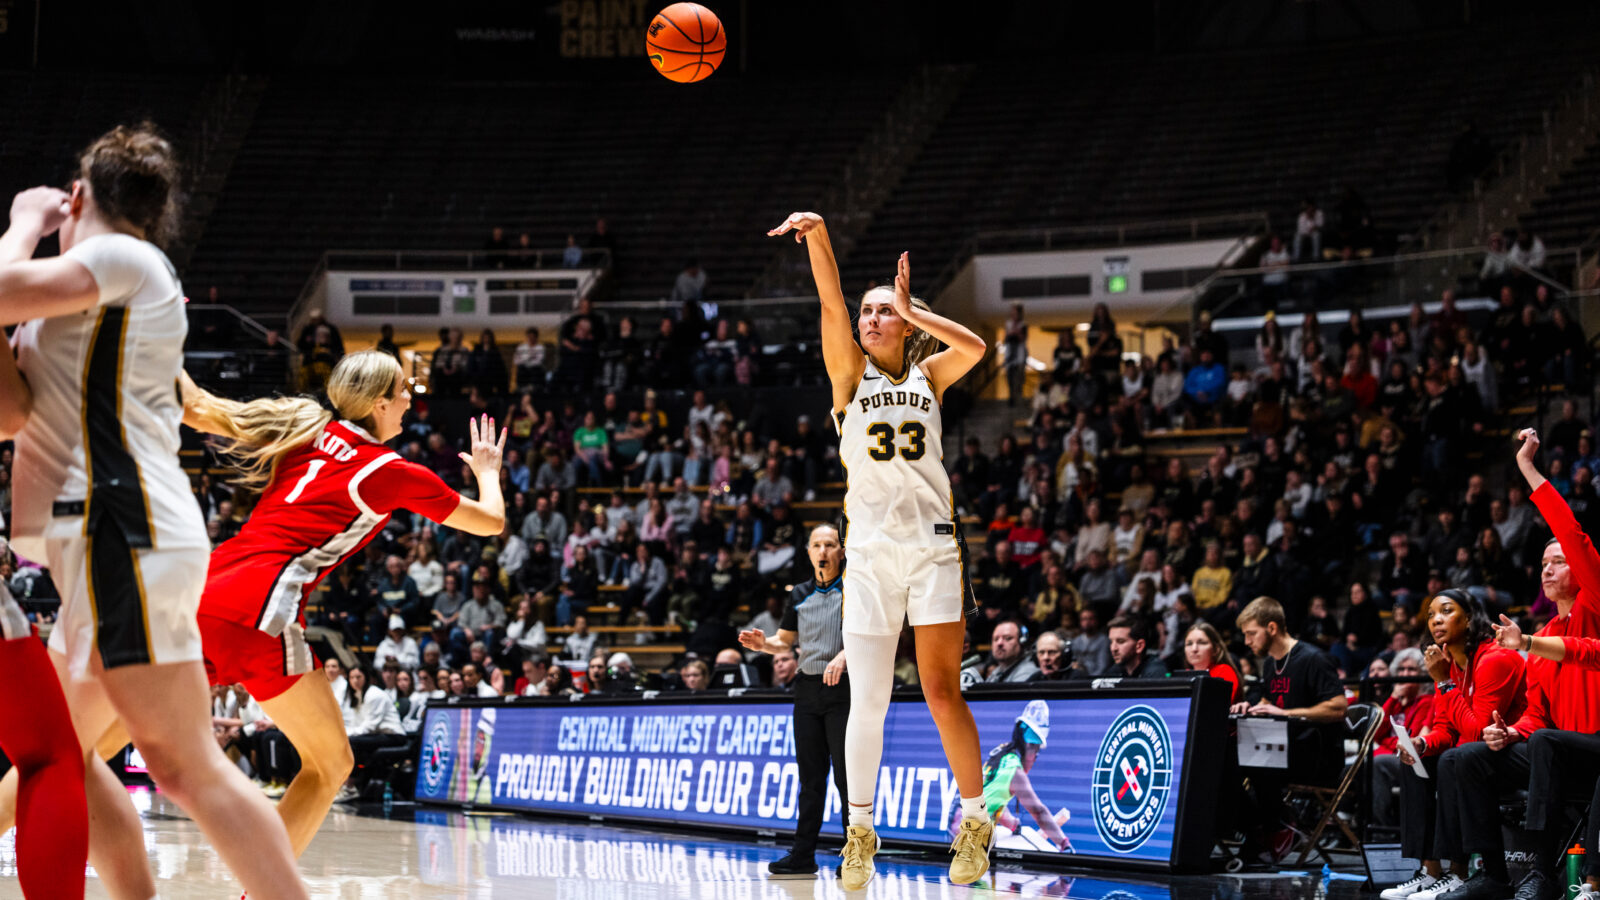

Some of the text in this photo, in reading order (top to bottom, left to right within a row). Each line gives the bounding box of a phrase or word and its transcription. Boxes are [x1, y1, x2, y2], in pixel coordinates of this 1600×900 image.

[560, 29, 645, 58] CREW
[859, 391, 932, 413] PURDUE
[866, 420, 926, 461] 33
[283, 458, 327, 504] 1
[557, 714, 797, 757] CENTRAL MIDWEST CARPEN
[1104, 720, 1165, 765] CENTRAL MIDWEST
[495, 753, 585, 803] PROUDLY
[583, 756, 694, 812] BUILDING
[695, 759, 755, 816] OUR
[757, 761, 958, 832] CONITY
[1100, 791, 1159, 838] CARPENTERS
